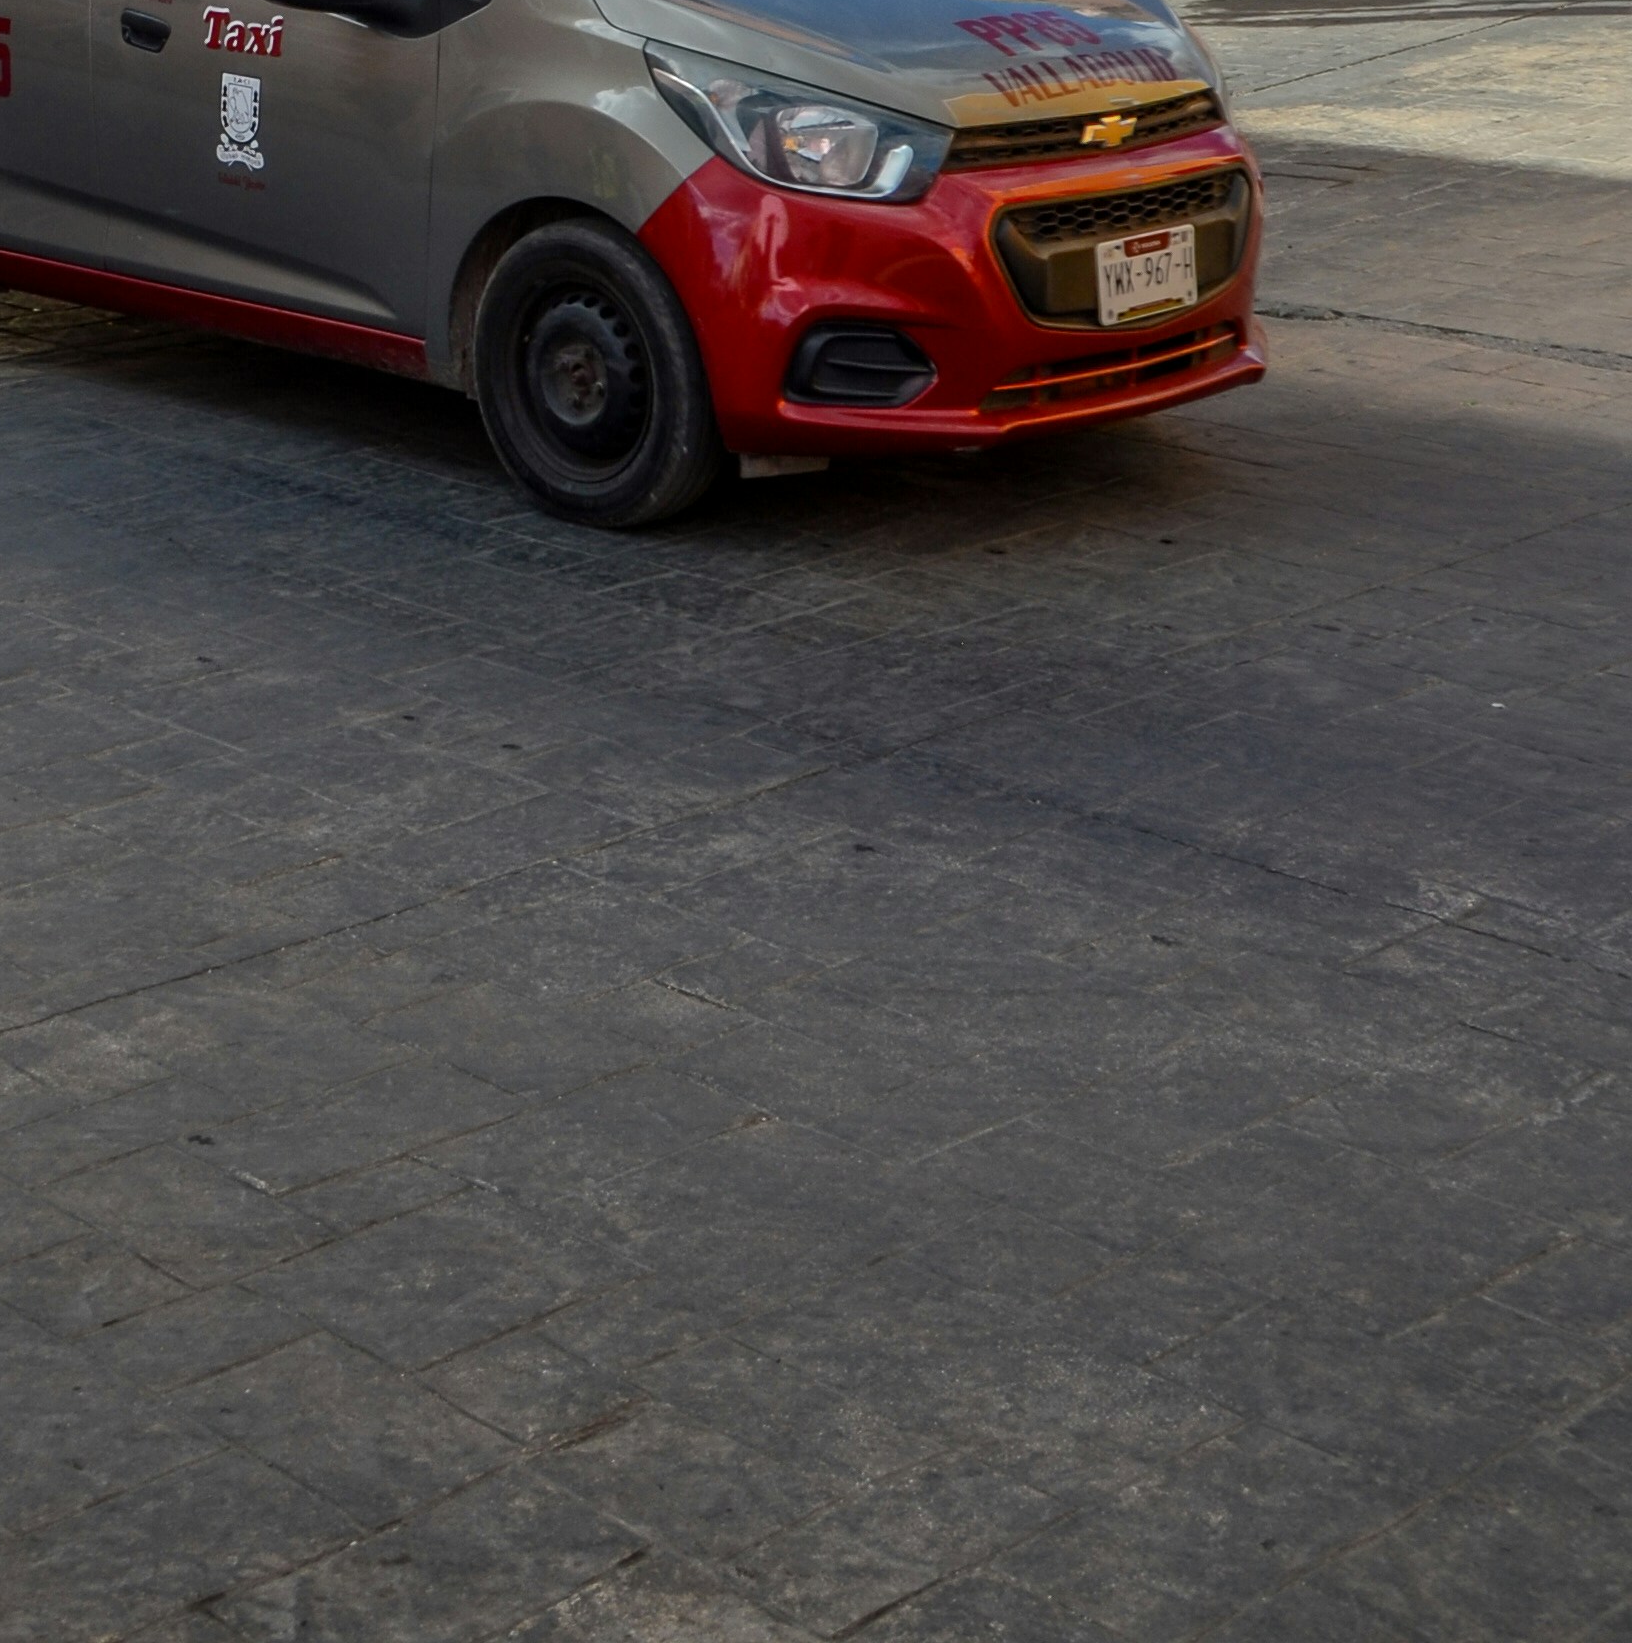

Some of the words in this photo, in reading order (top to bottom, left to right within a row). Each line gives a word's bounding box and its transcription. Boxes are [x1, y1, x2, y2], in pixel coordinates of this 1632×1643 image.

[203, 6, 284, 57] Taxi
[954, 11, 1101, 56] PP85
[981, 47, 1177, 107] VALLADOLID
